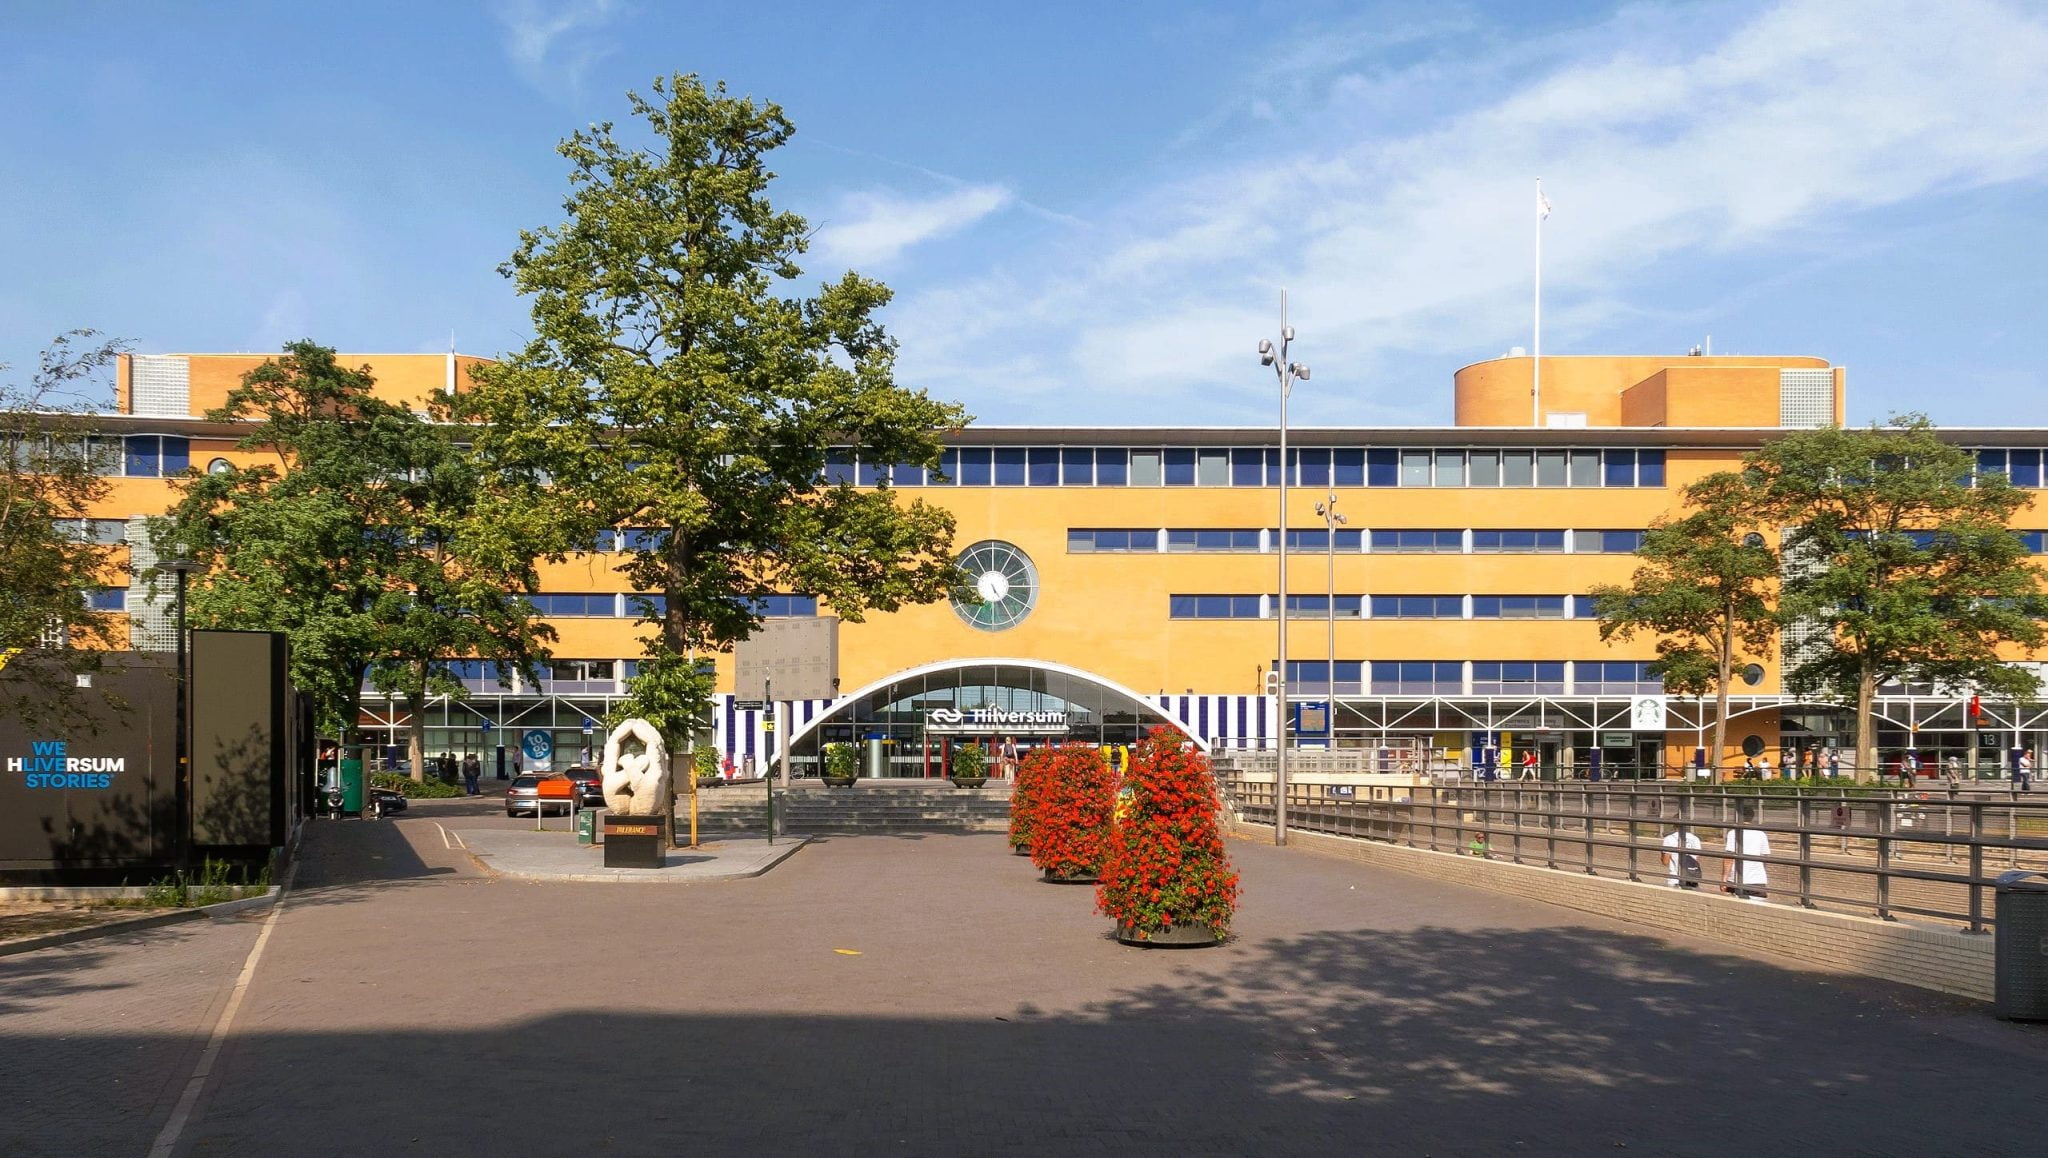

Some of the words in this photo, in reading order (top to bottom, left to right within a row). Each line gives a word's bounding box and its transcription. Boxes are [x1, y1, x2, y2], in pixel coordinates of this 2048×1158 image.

[973, 708, 1063, 723] Hilversum
[527, 734, 543, 746] to
[1983, 734, 1995, 745] 13
[32, 741, 66, 756] WE
[533, 742, 549, 758] go
[26, 773, 111, 788] STORIES
